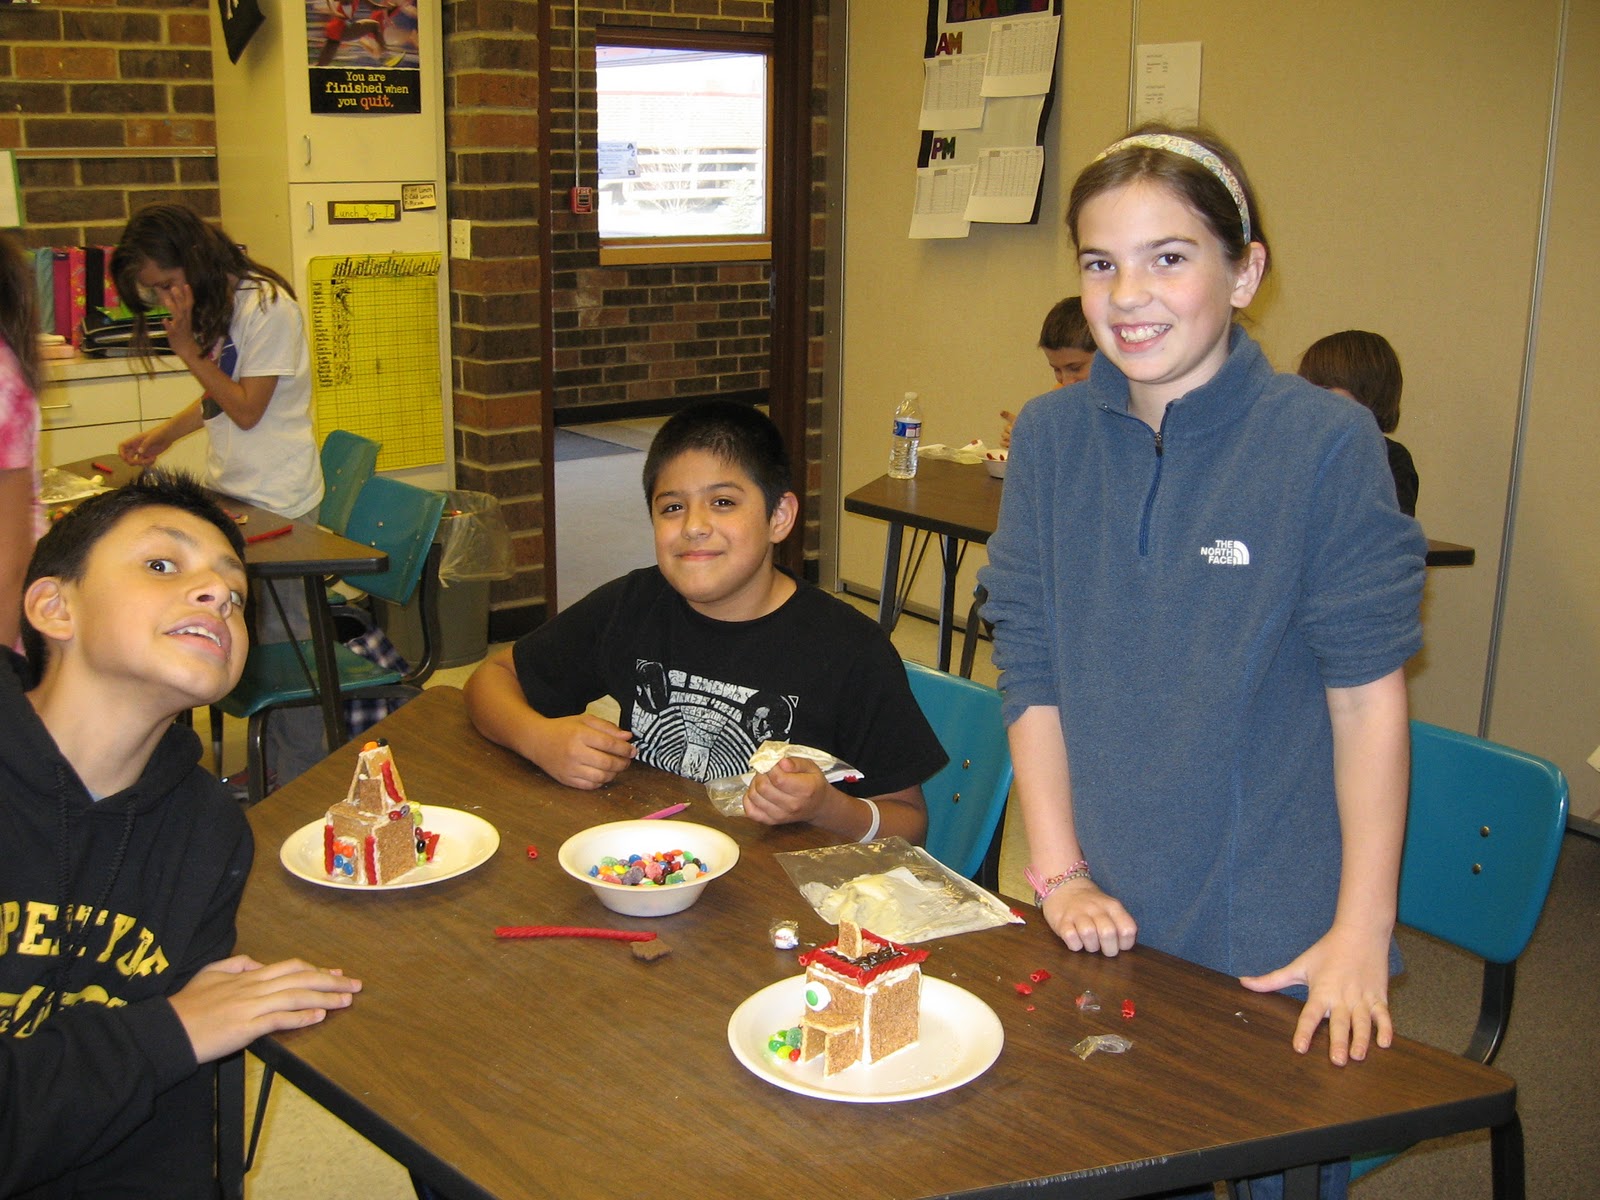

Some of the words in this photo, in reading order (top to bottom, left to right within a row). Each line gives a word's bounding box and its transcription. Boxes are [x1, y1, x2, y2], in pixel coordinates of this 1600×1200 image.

[936, 32, 963, 55] AM
[346, 71, 365, 82] You
[368, 73, 386, 82] are
[325, 81, 383, 94] finished
[384, 84, 409, 94] when
[338, 97, 357, 108] you
[360, 94, 394, 110] quit.
[931, 136, 956, 160] PM
[334, 205, 359, 217] Lunch
[1215, 539, 1234, 549] THE
[1200, 546, 1233, 557] NORTH
[1208, 555, 1233, 565] FACE
